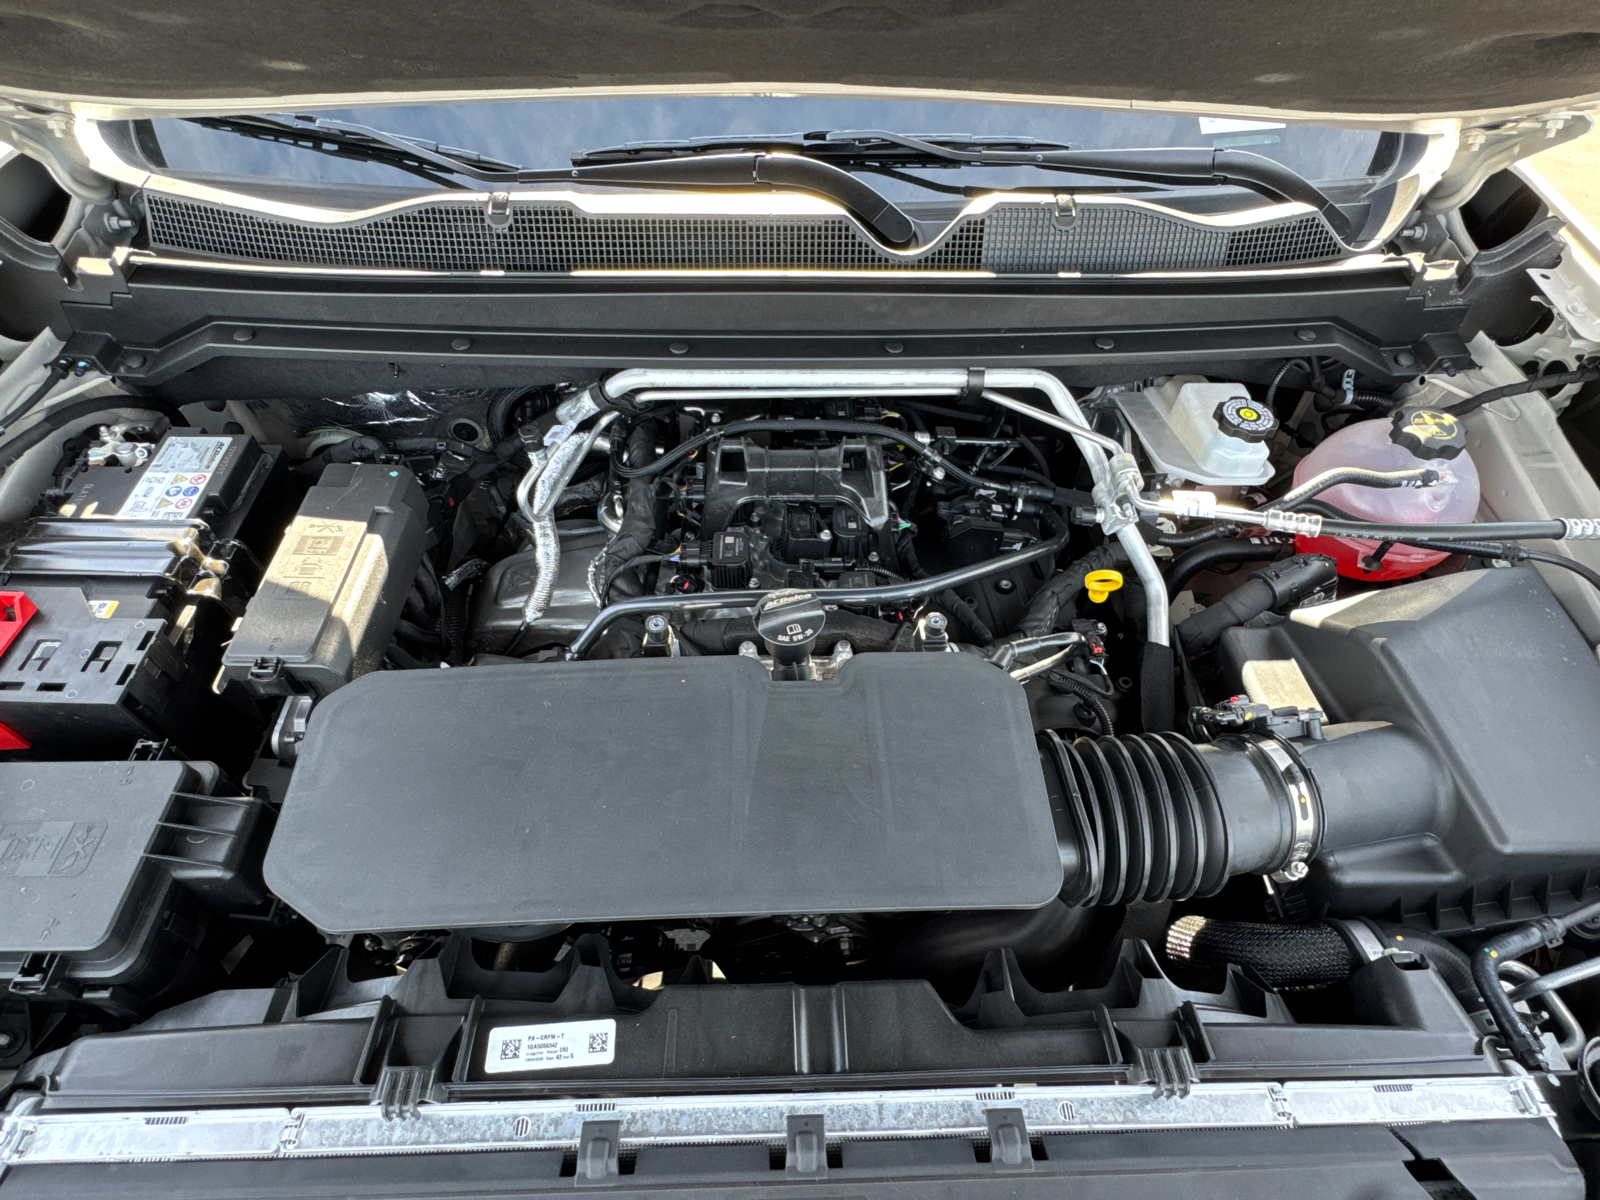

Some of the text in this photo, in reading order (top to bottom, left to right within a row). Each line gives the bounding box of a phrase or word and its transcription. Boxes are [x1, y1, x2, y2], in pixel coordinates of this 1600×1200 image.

[204, 441, 225, 469] ACDelco
[763, 593, 812, 610] ACDelco
[777, 634, 790, 642] SAE
